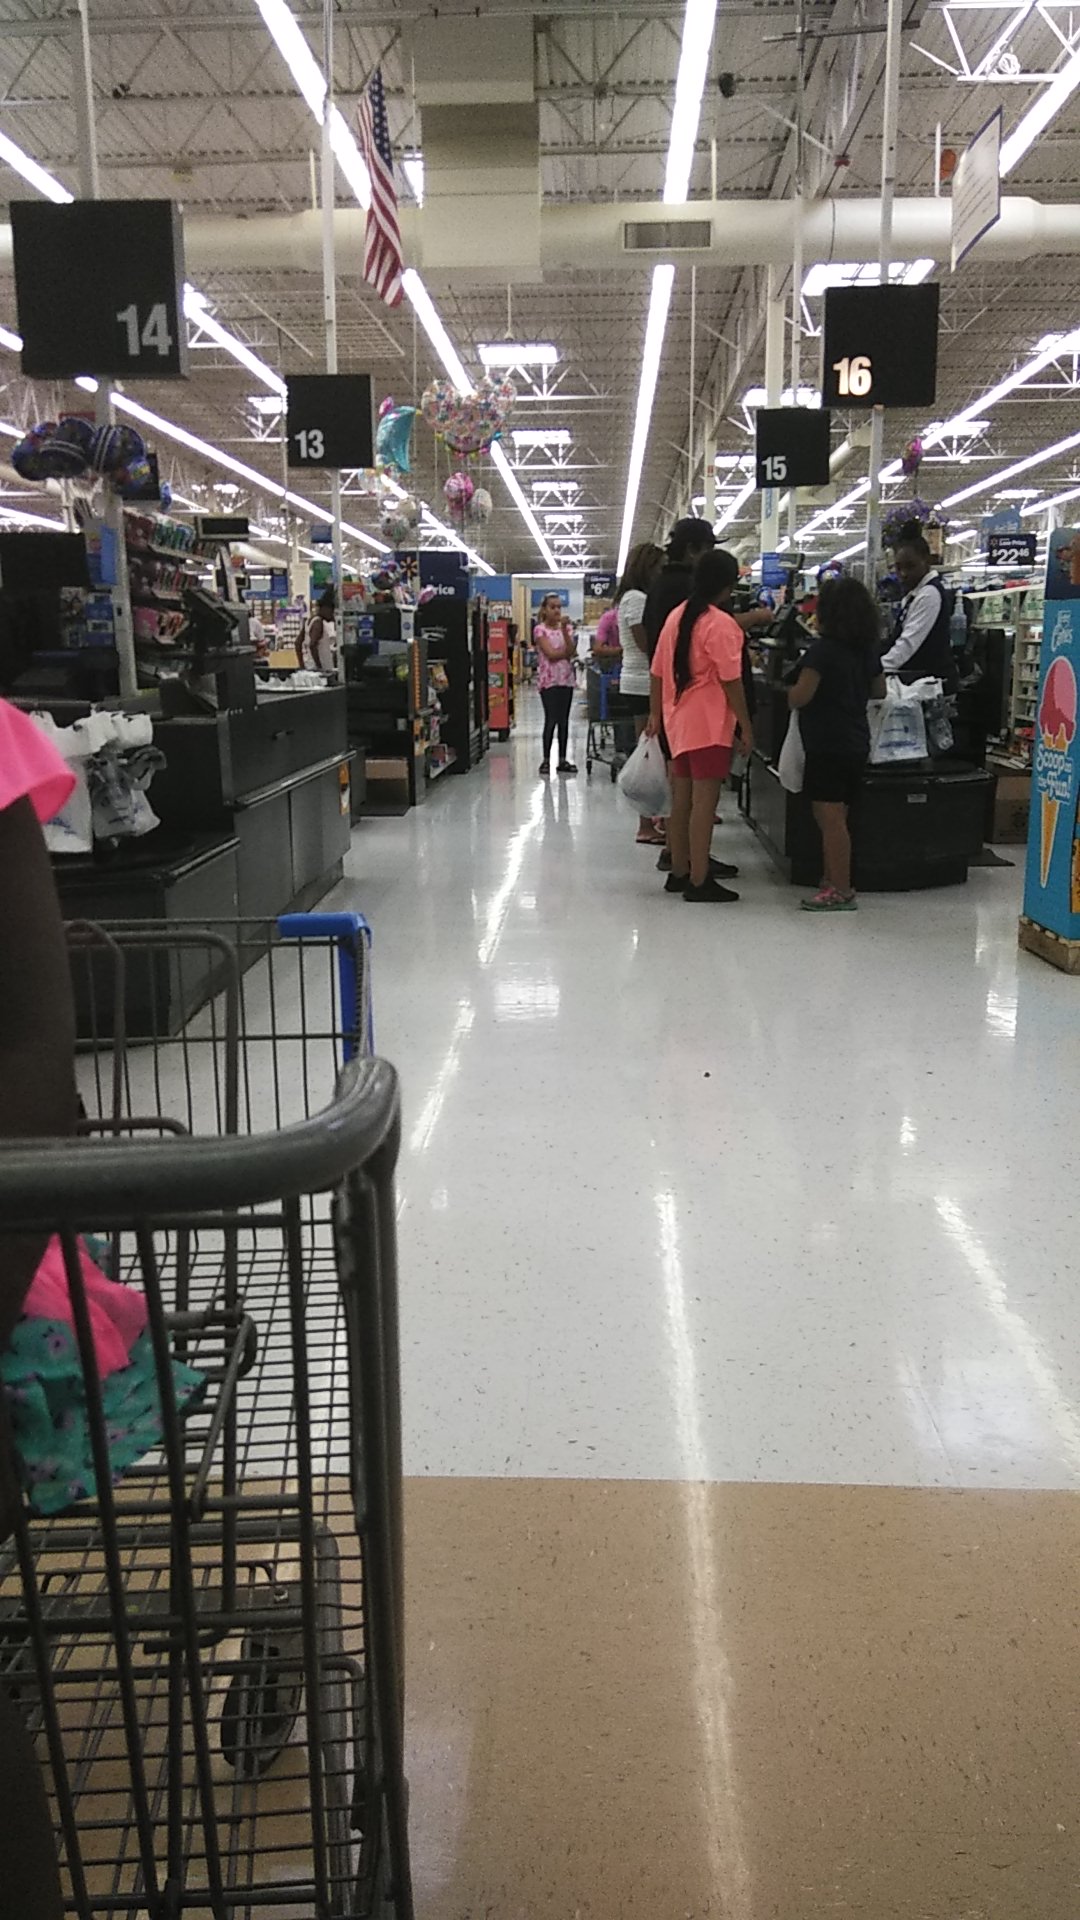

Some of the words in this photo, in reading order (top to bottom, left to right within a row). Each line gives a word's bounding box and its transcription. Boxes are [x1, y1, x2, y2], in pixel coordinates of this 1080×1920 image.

[116, 303, 173, 356] 14
[832, 356, 872, 397] 16
[294, 429, 325, 459] 13
[761, 455, 787, 481] 15
[1036, 743, 1067, 776] Scoop
[1046, 770, 1072, 800] Fun!
